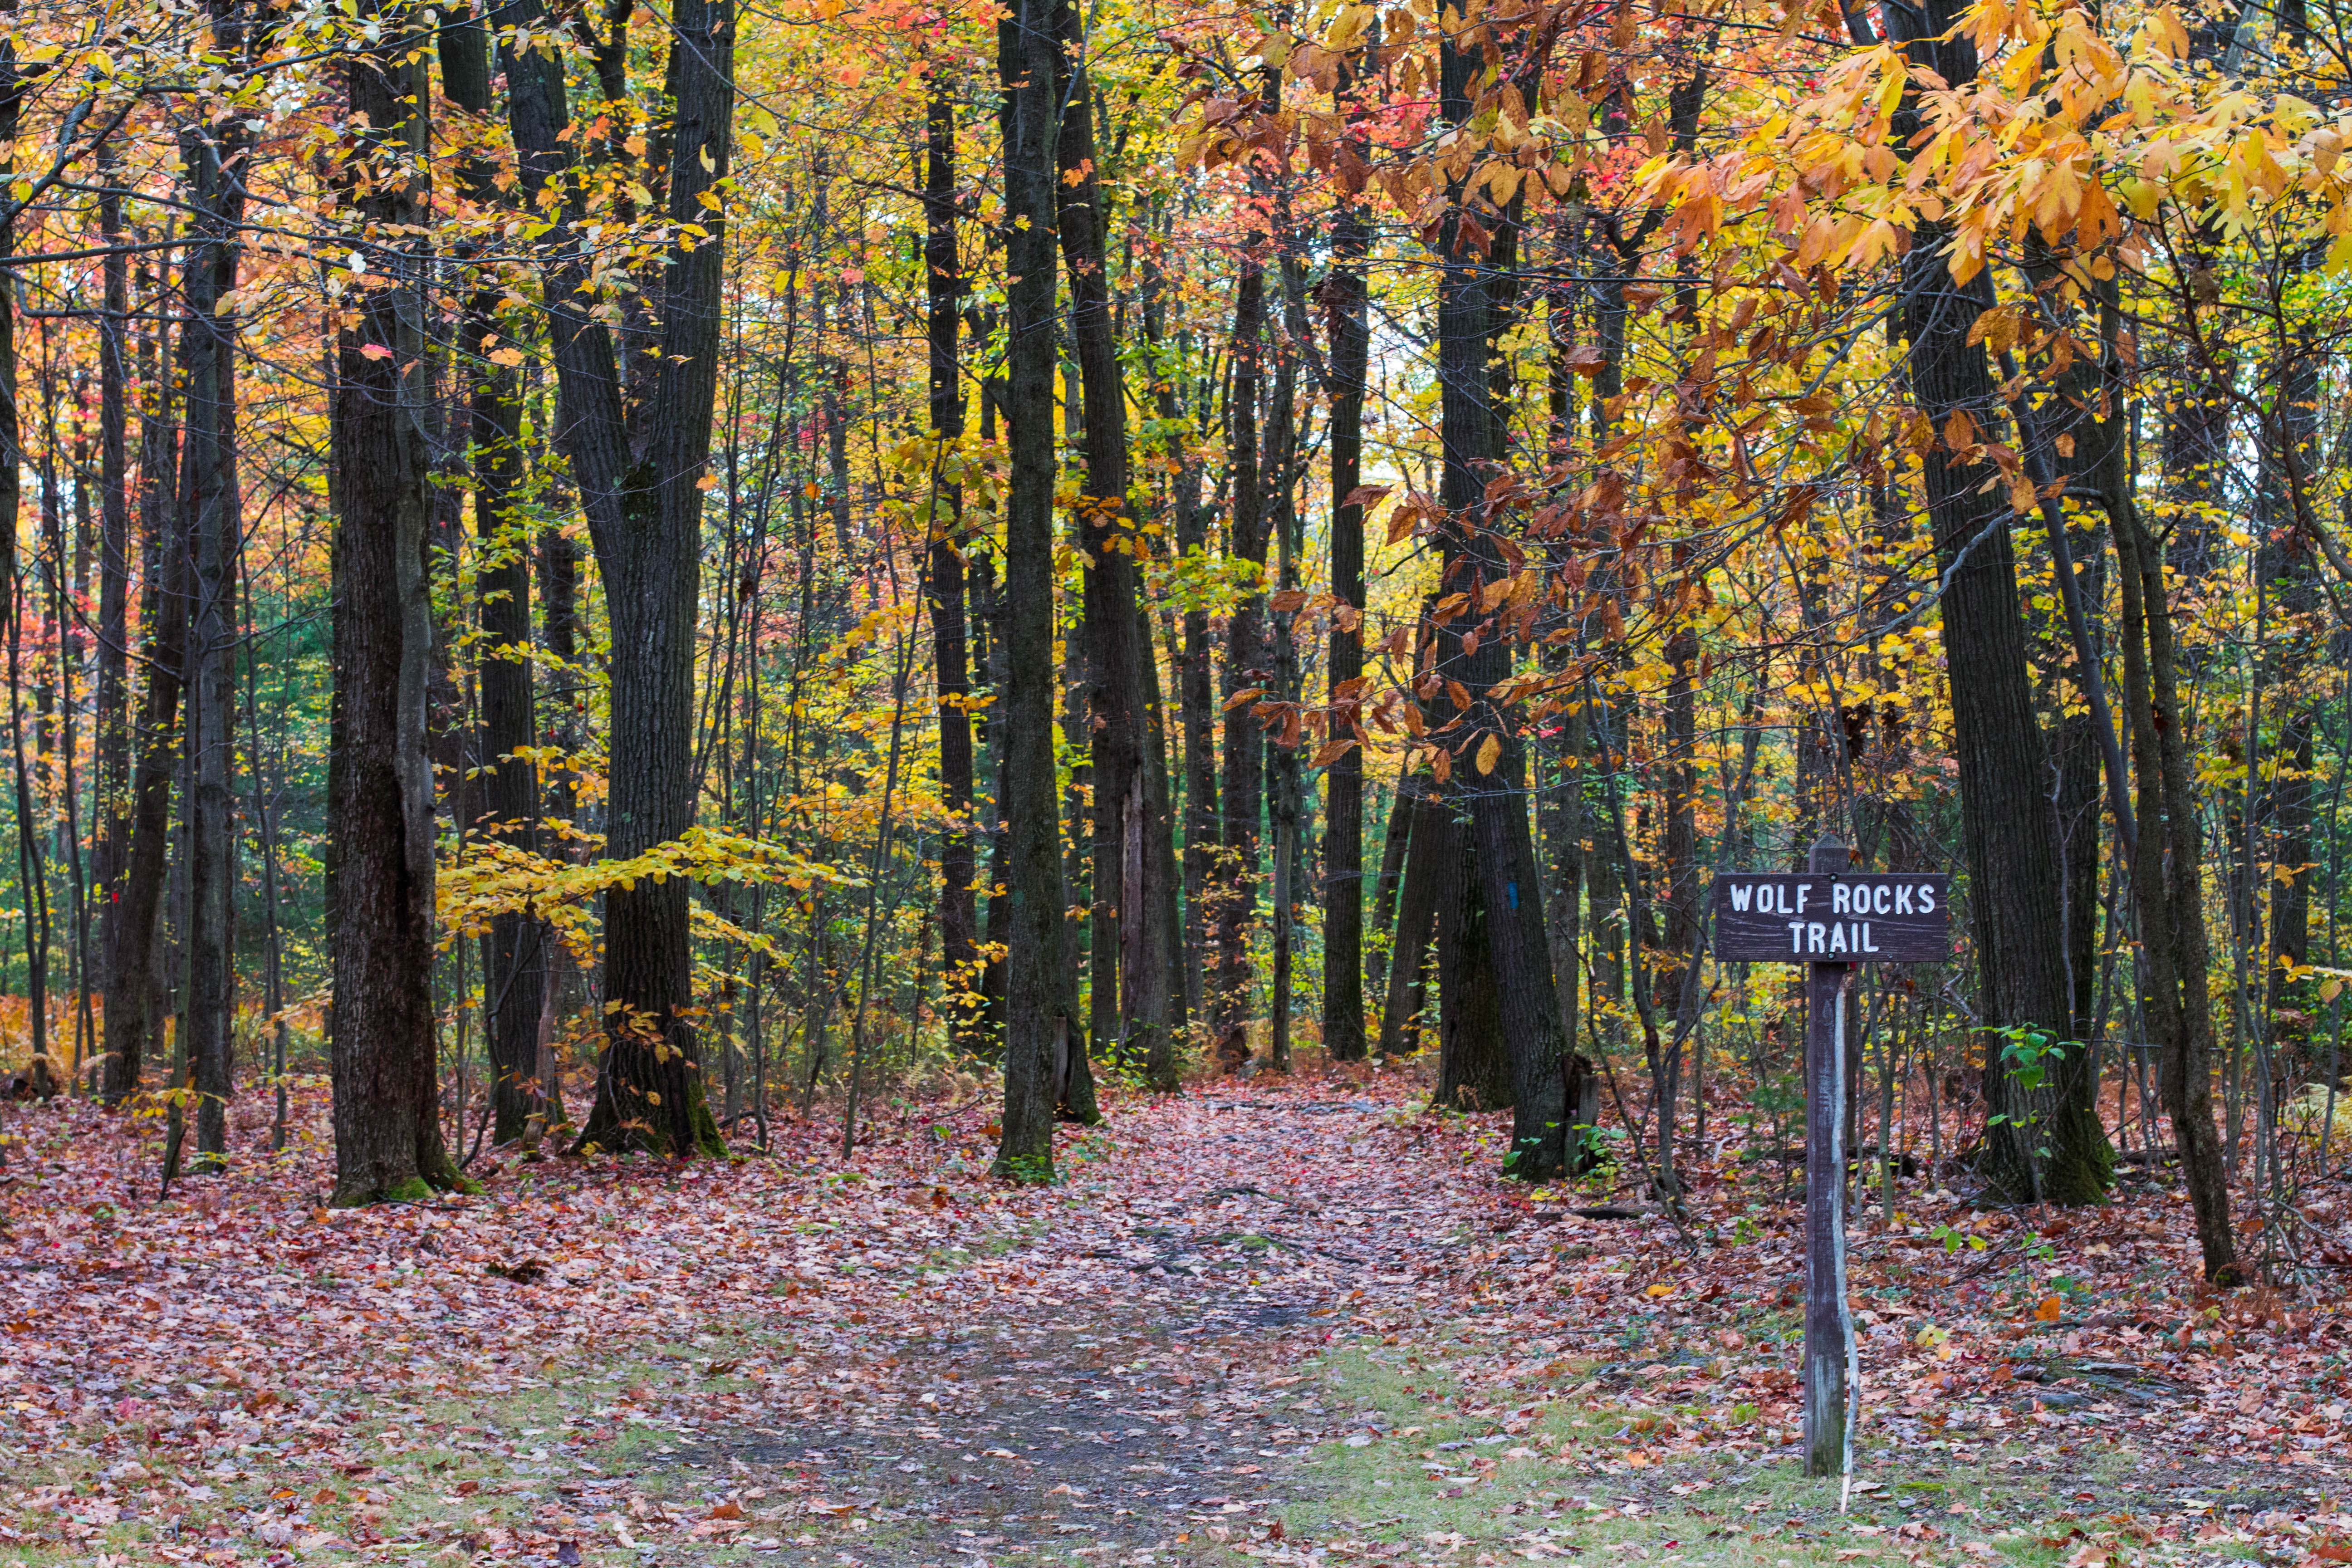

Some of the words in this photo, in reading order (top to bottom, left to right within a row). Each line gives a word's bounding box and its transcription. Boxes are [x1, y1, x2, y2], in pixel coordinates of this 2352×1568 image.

[1730, 884, 1813, 914] WOLF
[1833, 883, 1936, 915] ROCKS
[1788, 921, 1880, 954] TRAIL
